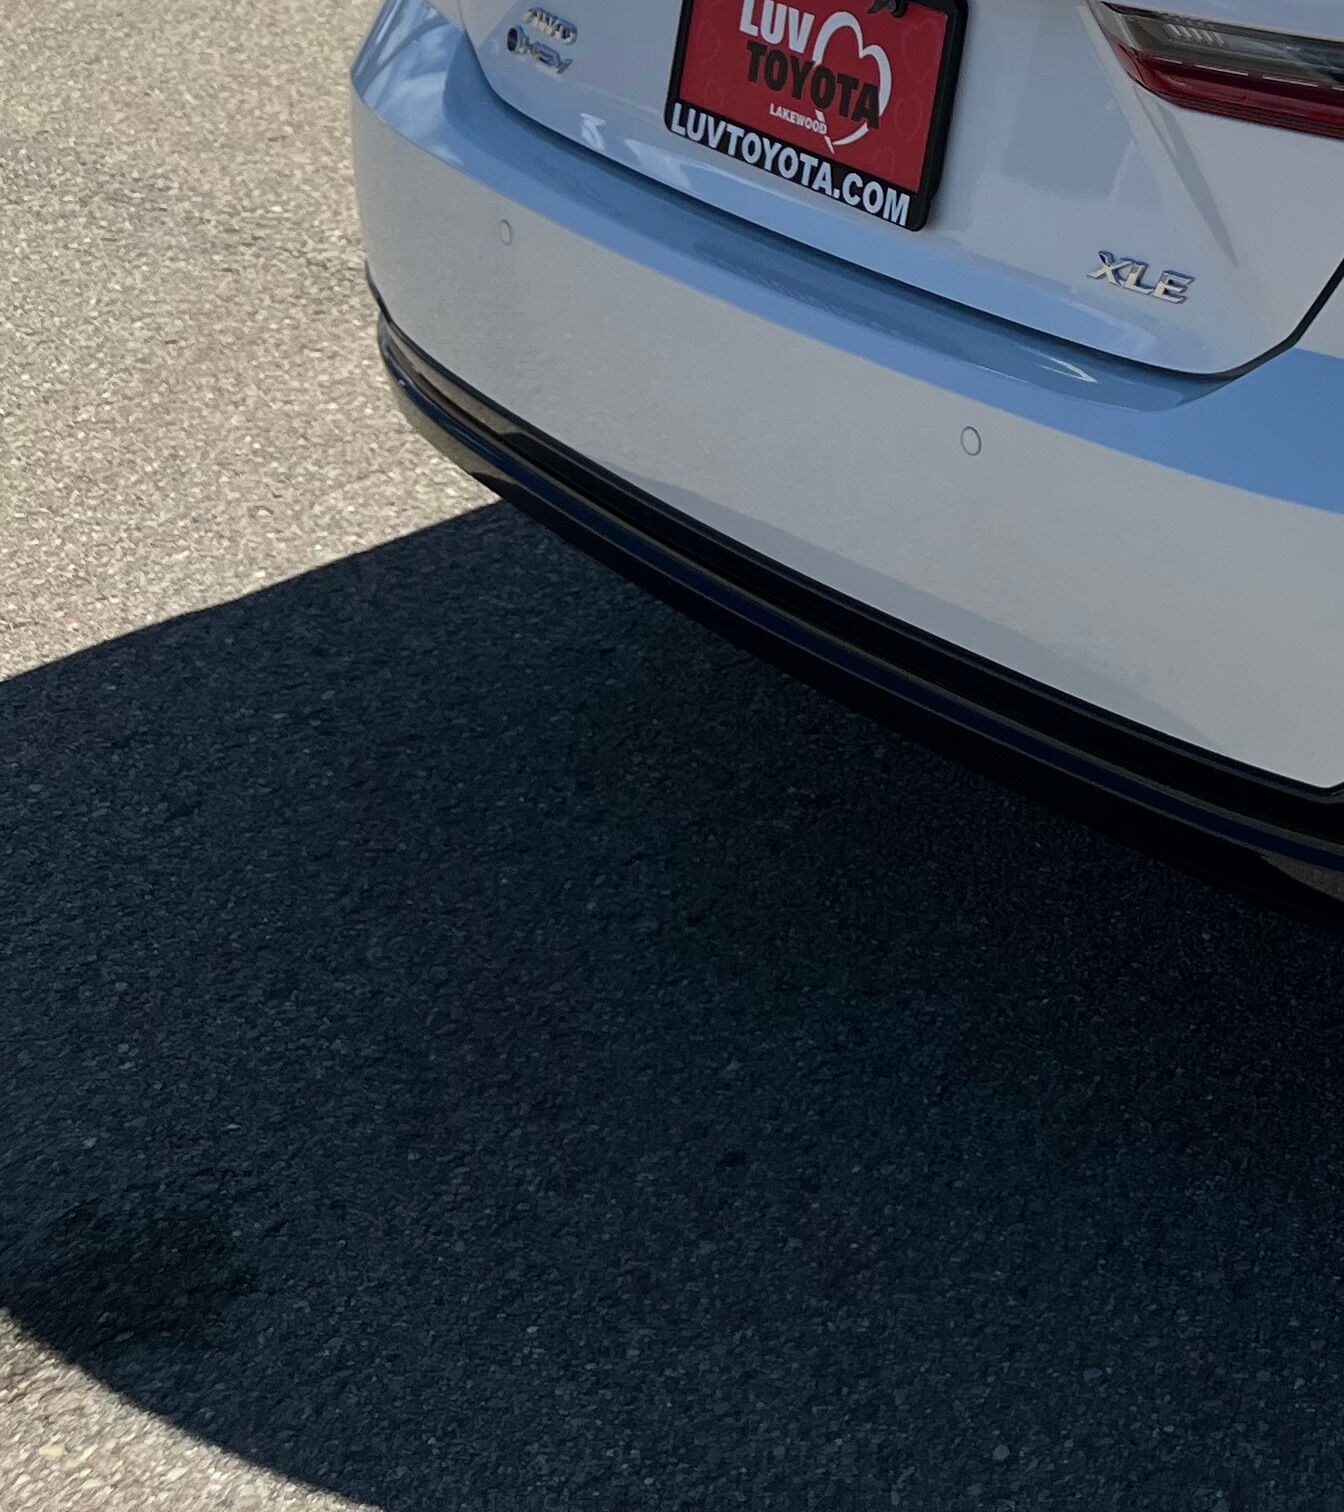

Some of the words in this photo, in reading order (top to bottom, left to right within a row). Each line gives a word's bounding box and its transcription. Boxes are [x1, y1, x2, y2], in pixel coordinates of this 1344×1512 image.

[522, 7, 578, 46] AWD
[746, 39, 881, 129] TOYOTA
[768, 102, 828, 135] LAKEWOOD
[670, 102, 911, 226] LUVTOYOTA.COM
[1087, 250, 1195, 304] XLE
